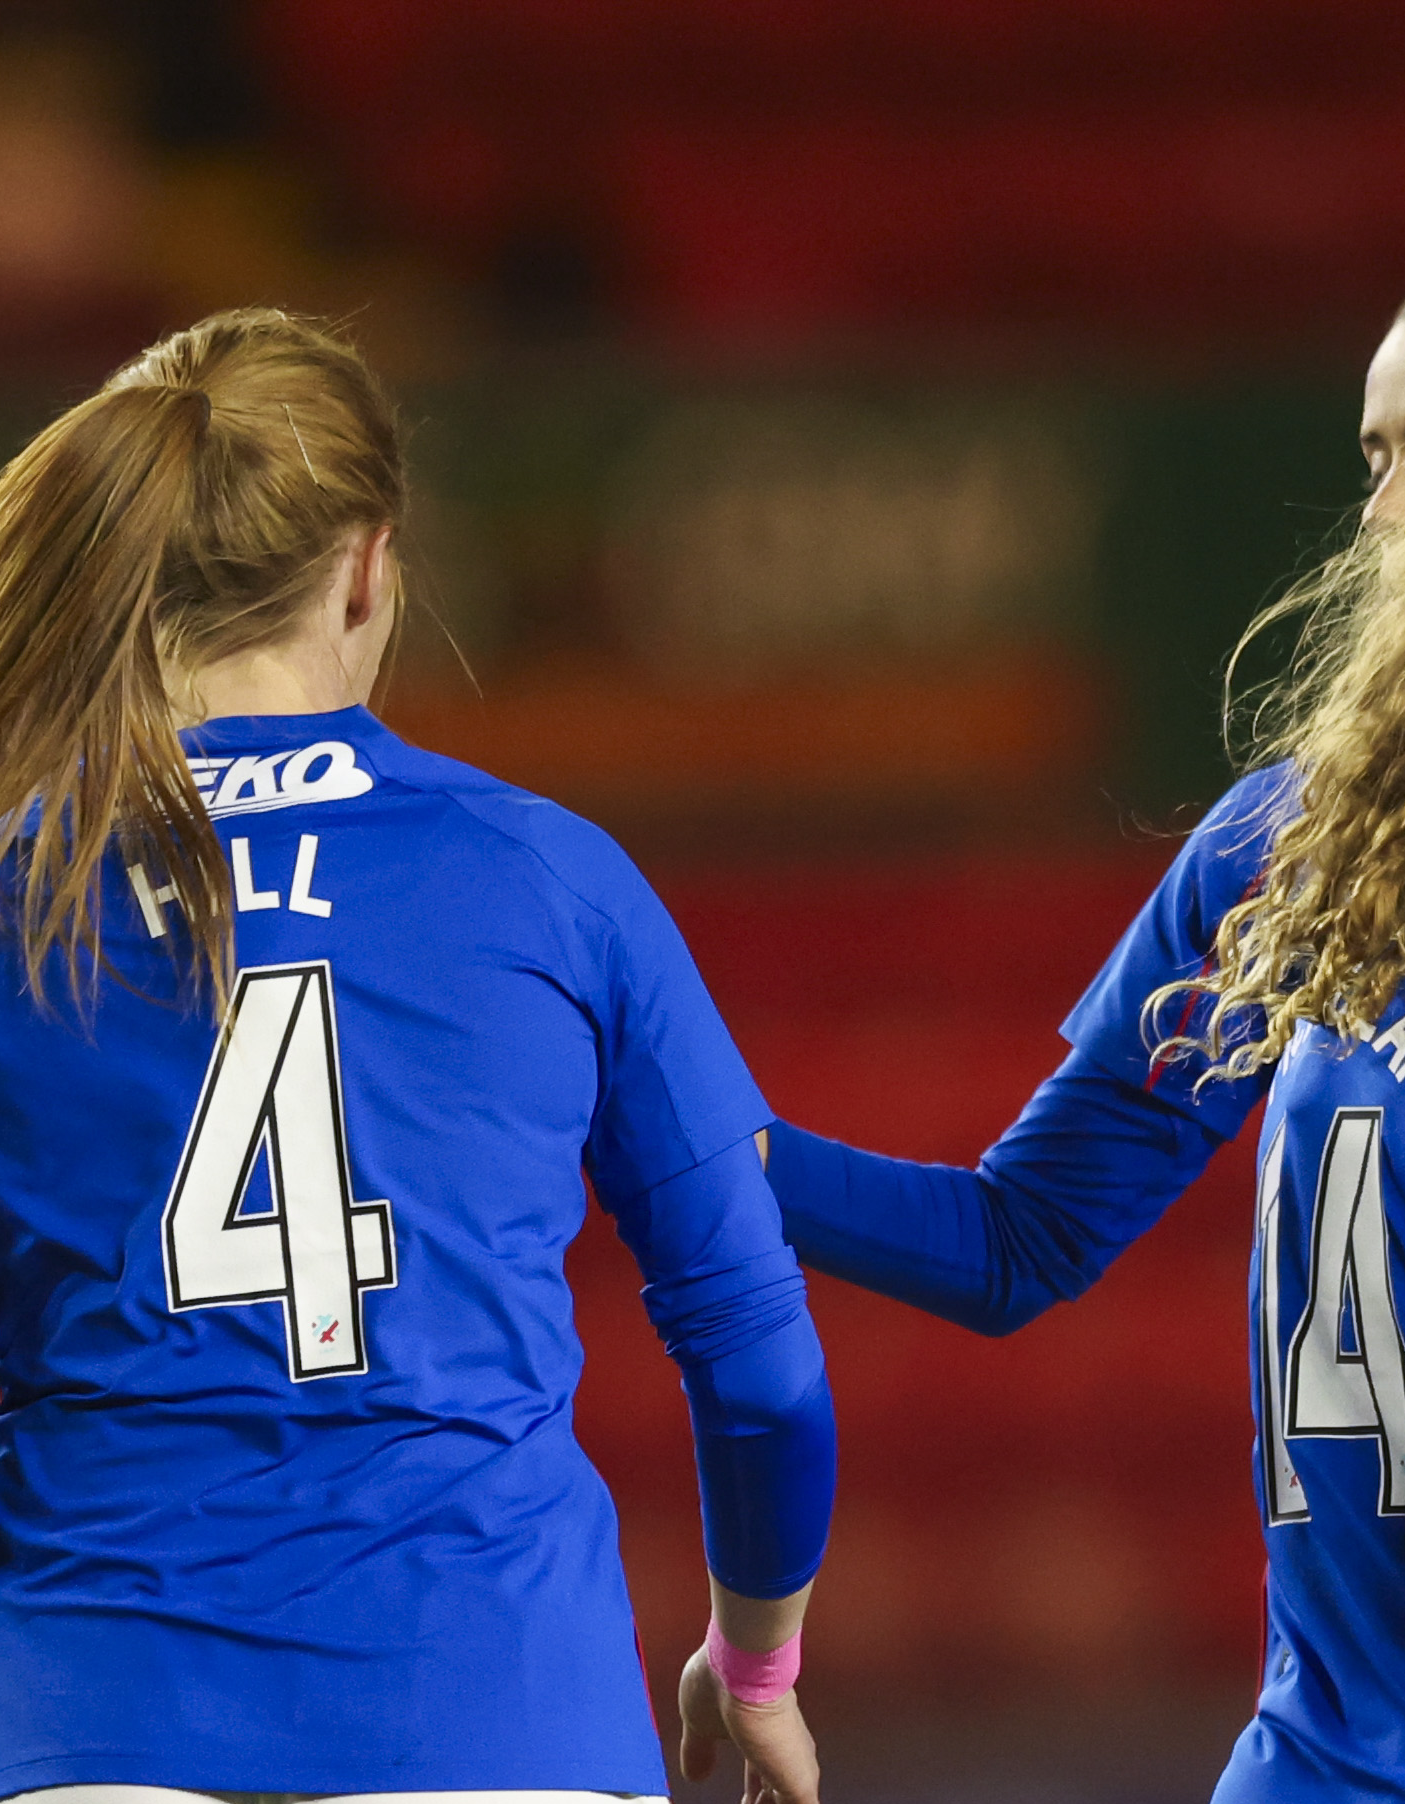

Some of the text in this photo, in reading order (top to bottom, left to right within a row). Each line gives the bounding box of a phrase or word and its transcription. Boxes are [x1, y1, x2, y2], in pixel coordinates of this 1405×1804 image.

[142, 741, 374, 824] EKO
[126, 834, 333, 938] HLL
[162, 959, 397, 1383] 4
